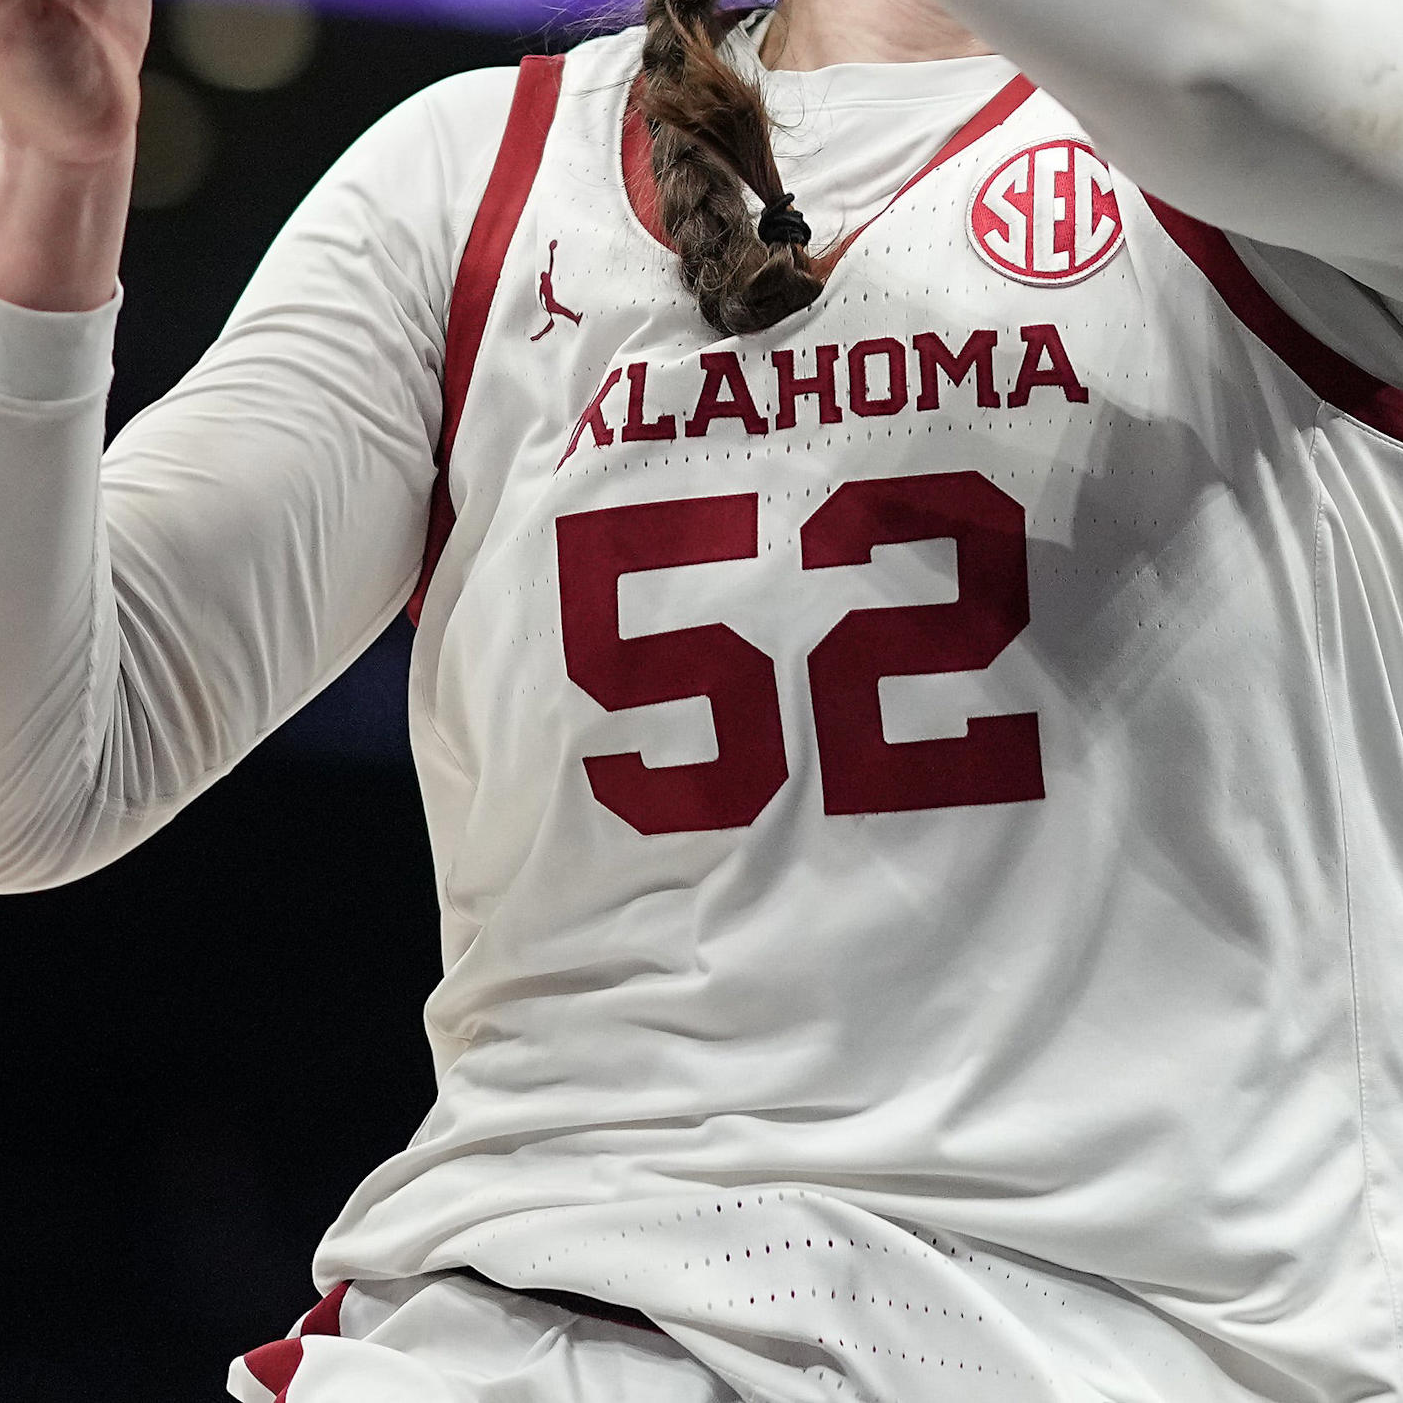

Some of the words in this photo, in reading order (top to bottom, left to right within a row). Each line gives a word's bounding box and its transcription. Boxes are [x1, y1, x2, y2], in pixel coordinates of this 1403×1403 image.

[981, 147, 1117, 272] SEC
[552, 323, 1090, 477] KLAHOMA
[555, 469, 1046, 837] 52
